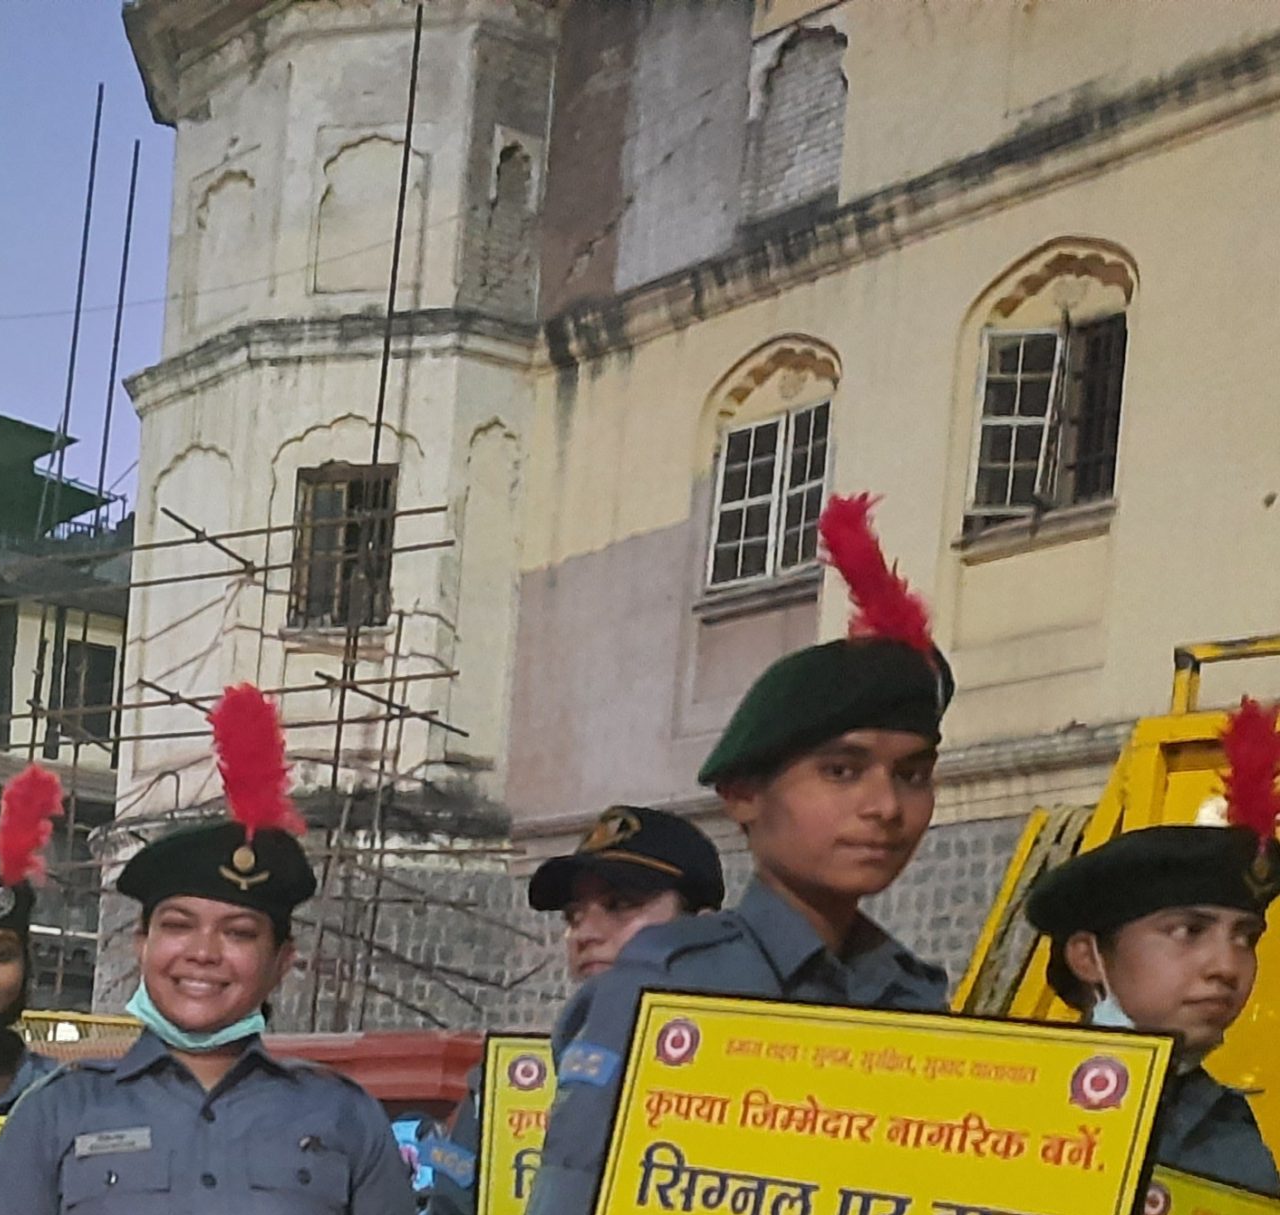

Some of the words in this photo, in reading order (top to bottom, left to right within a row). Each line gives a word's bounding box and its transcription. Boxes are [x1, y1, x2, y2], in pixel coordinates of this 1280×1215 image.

[507, 1109, 548, 1138] कृप
[645, 1089, 729, 1130] कृपया
[738, 1091, 877, 1144] जिम्मेदार
[886, 1112, 1027, 1160] नागरिक
[1040, 1125, 1106, 1172] बनें.
